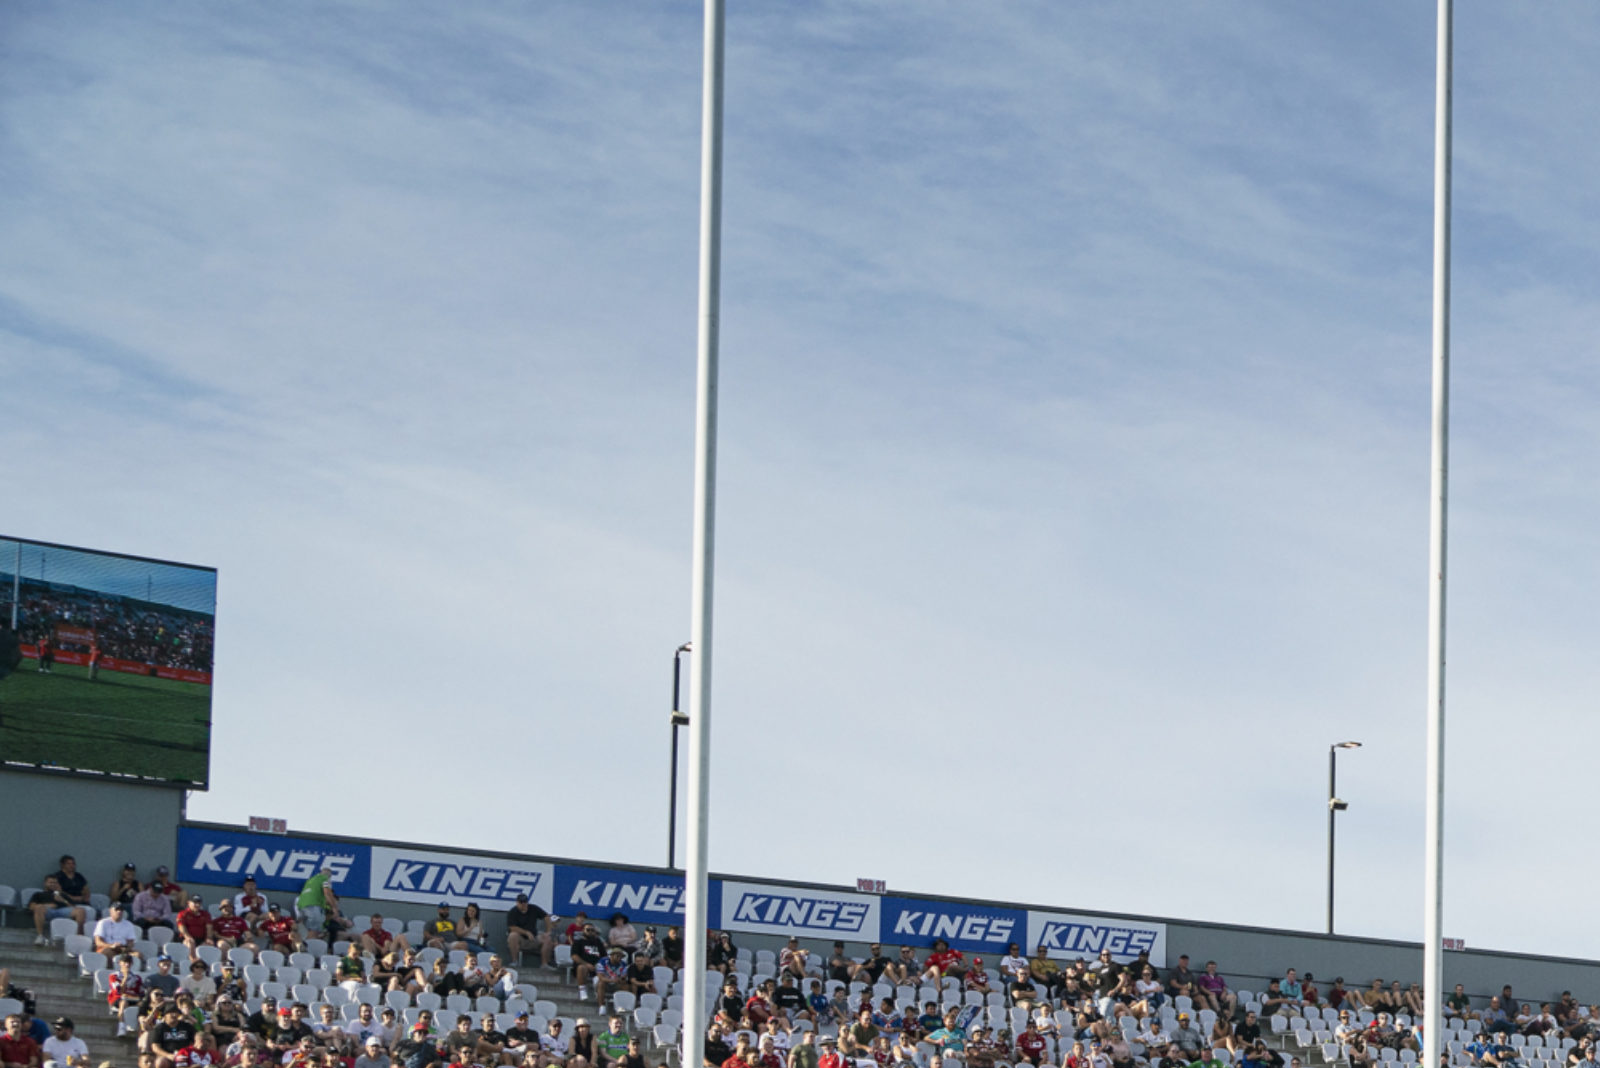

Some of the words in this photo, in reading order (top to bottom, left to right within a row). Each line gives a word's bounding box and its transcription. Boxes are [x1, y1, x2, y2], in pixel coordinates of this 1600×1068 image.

[193, 844, 354, 882] KINGS
[384, 860, 541, 901] KINGS
[733, 893, 870, 932] KINGS
[894, 911, 1015, 943] KINGS
[1041, 921, 1157, 955] KINGS
